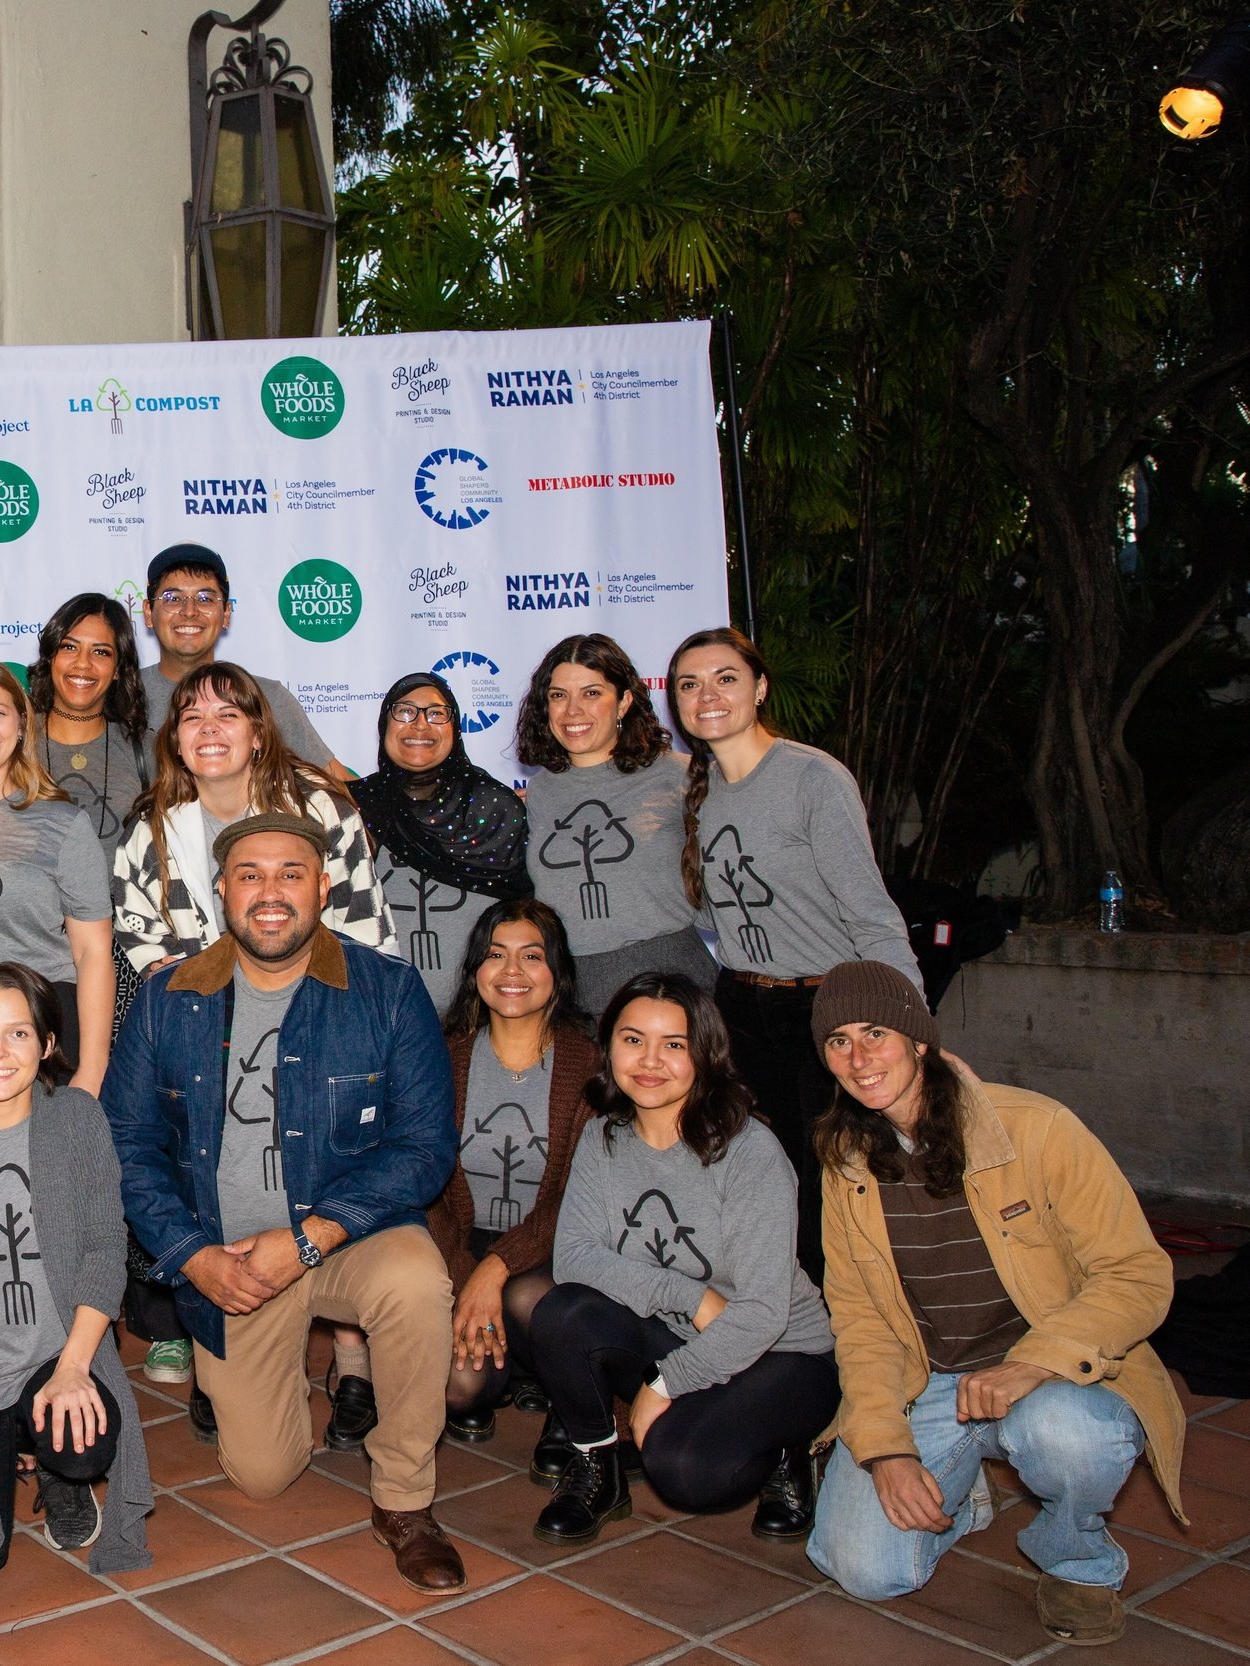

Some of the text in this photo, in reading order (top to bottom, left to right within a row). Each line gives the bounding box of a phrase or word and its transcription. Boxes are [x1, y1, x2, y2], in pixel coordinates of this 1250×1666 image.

[391, 358, 438, 391] Black
[487, 369, 572, 388] NITHYA
[590, 369, 639, 378] Los Angeles
[268, 382, 335, 398] WHOLE
[408, 377, 451, 402] Sheep
[592, 378, 678, 390] City Councilmember
[491, 389, 573, 407] RAMAN
[593, 391, 640, 400] 4th District
[69, 396, 220, 412] LA COMPOST
[274, 398, 335, 414] FOODS
[86, 468, 135, 497] Black
[183, 479, 267, 496] NITHYA
[285, 480, 335, 490] Los Angeles
[528, 473, 675, 491] METABOLIC STUDIO
[102, 484, 146, 509] Sheep
[286, 487, 375, 500] City Councilmember
[185, 497, 267, 515] RAMAN
[287, 501, 336, 510] 4th District
[409, 562, 457, 593] Black
[506, 572, 589, 591] NITHYA
[607, 573, 656, 582] Los Angeles
[286, 584, 353, 601] WHOLE
[423, 579, 469, 604] Sheep
[607, 581, 694, 593] City Councilmember
[507, 591, 589, 610] RAMAN
[607, 594, 655, 603] 4th District
[291, 600, 352, 616] FOODS
[297, 682, 349, 693] Los Angeles
[298, 694, 315, 704] City
[315, 704, 348, 713] District
